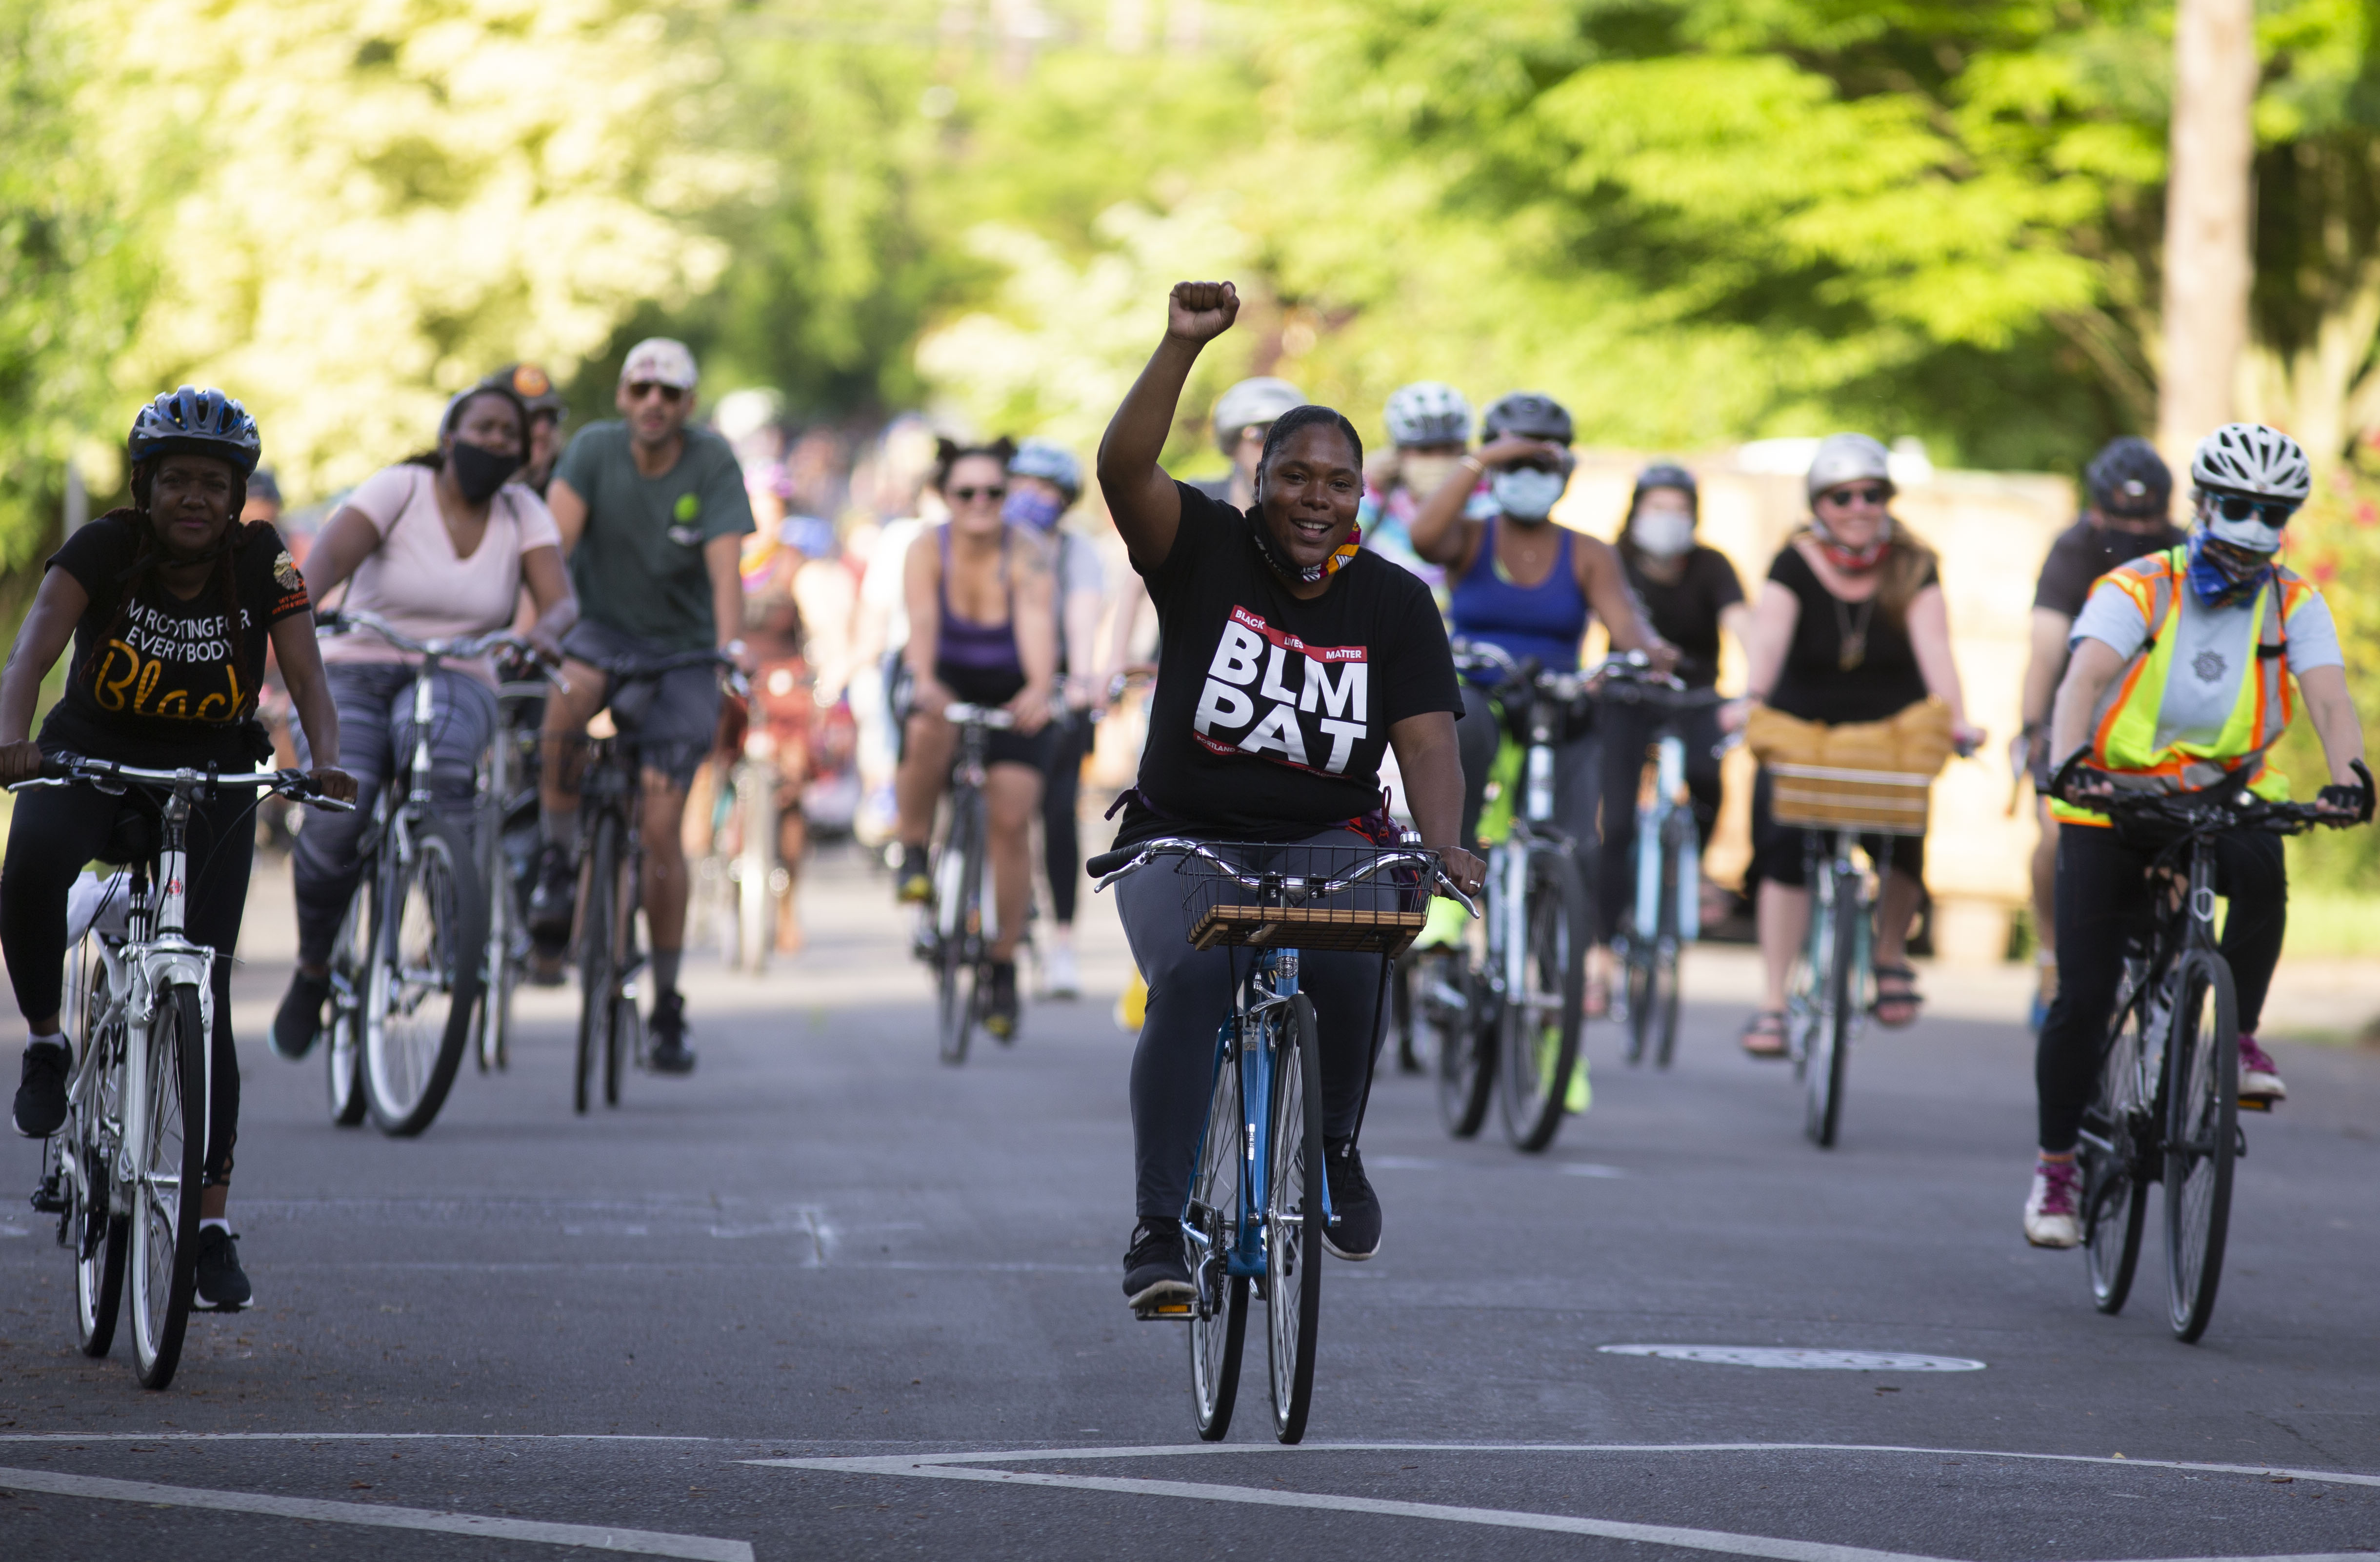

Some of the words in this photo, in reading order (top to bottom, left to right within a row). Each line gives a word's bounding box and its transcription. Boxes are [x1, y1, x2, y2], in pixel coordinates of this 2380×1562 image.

[117, 597, 145, 622] M
[144, 608, 214, 640] ROOTING
[215, 608, 251, 636] FR
[1235, 609, 1265, 630] BLACK
[1284, 636, 1304, 650] LIVES
[1326, 649, 1362, 660] MATTER
[125, 625, 233, 663] EVERYBODY
[1208, 620, 1367, 722] BLM
[1194, 677, 1367, 774] PAT
[1197, 735, 1236, 752] PORTLAND
